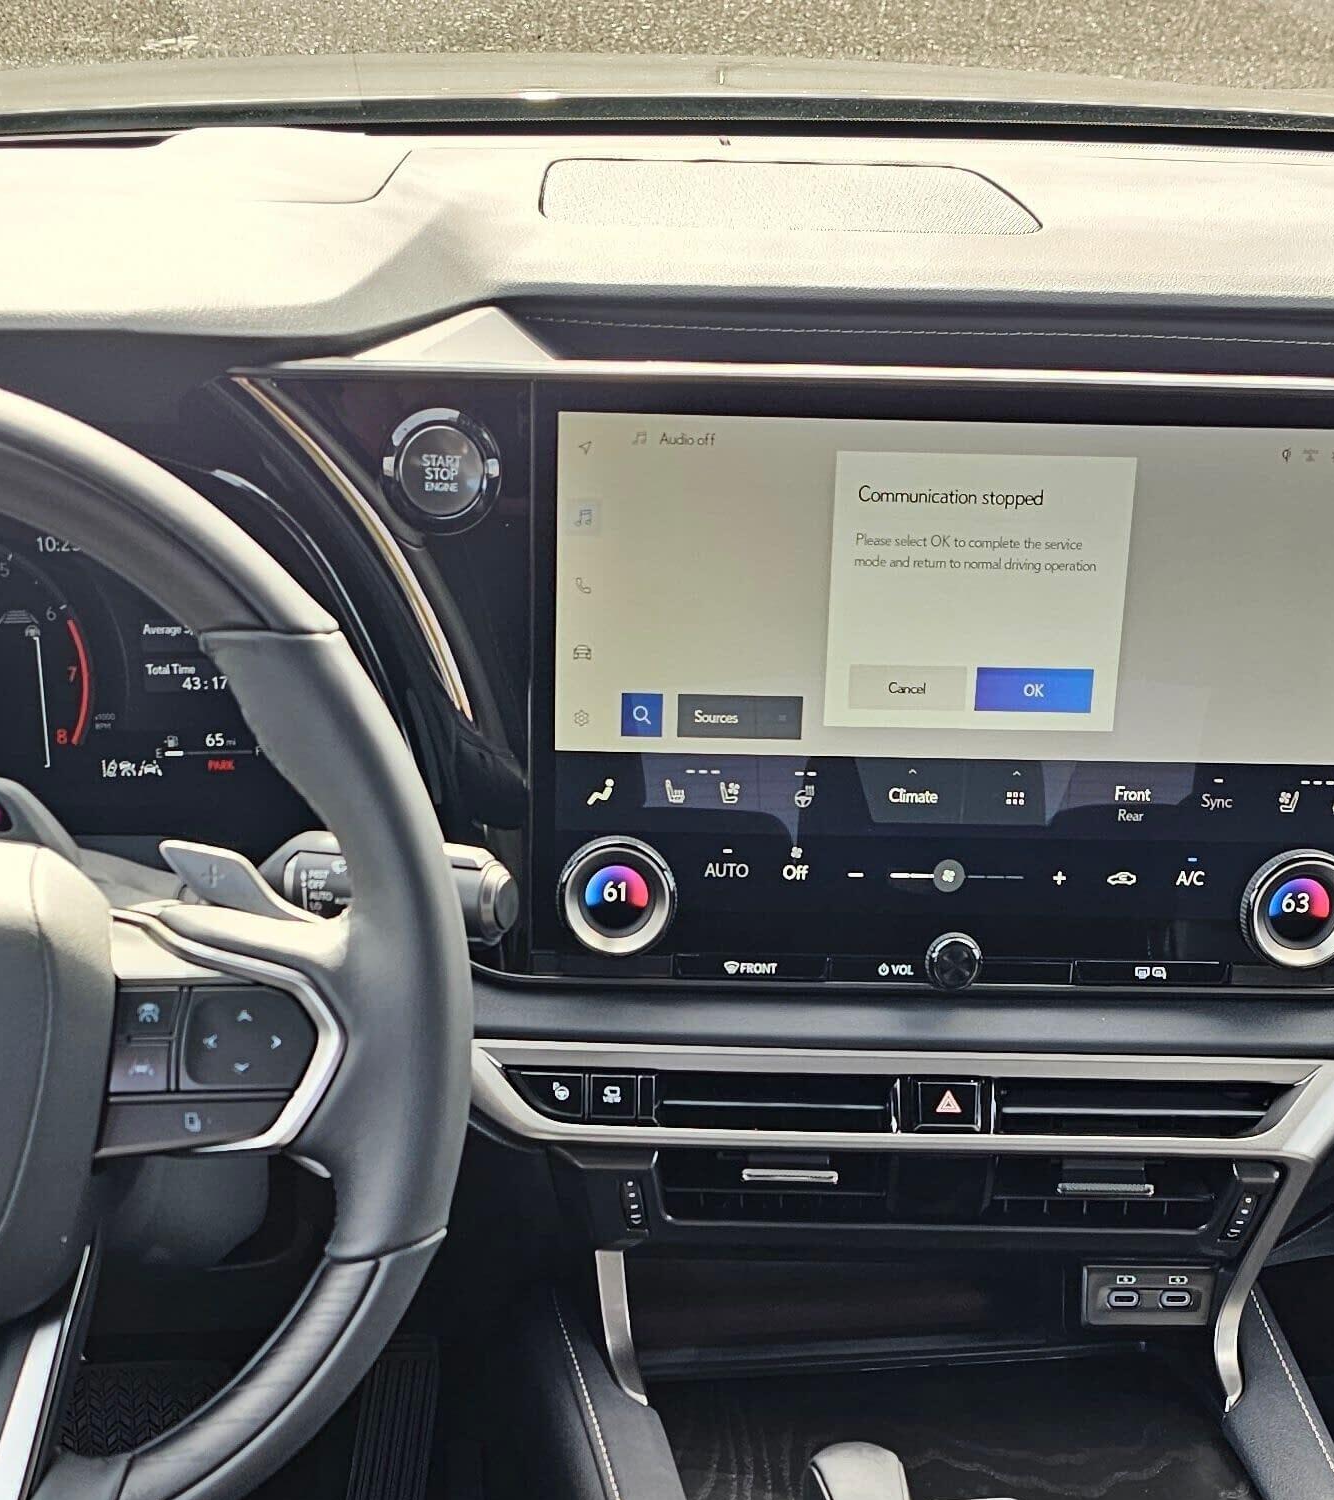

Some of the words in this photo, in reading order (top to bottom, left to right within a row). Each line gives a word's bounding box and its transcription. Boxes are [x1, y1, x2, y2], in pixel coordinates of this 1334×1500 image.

[659, 433, 694, 446] Audio
[697, 432, 716, 446] off
[422, 454, 461, 467] START
[425, 467, 458, 480] STOP
[425, 482, 458, 492] ENGINE
[858, 485, 977, 505] Communication
[982, 489, 1044, 509] stopped
[855, 533, 892, 546] Please
[894, 534, 927, 547] select
[930, 534, 951, 548] OK
[954, 537, 966, 548] to
[968, 536, 1020, 551] complete
[1024, 537, 1042, 550] the
[1045, 539, 1083, 551] service
[854, 556, 886, 568] mode
[889, 556, 910, 568] and
[913, 559, 947, 569] return
[949, 559, 961, 569] to
[963, 557, 1002, 570] normal
[1004, 557, 1041, 573] driving
[1044, 559, 1097, 573] operation
[45, 606, 57, 621] 6
[142, 623, 182, 637] Average
[67, 667, 77, 682] 7
[145, 663, 170, 675] Total
[172, 663, 196, 675] Time
[182, 676, 228, 690] 43:17
[888, 681, 927, 696] Cancel
[1023, 683, 1045, 698] OK
[694, 709, 739, 725] Sources
[56, 729, 68, 744] 8
[205, 733, 225, 747] 65
[888, 786, 940, 804] Climate
[1115, 785, 1152, 802] Front
[1201, 793, 1234, 811] Sync
[1117, 808, 1145, 823] Rear
[704, 862, 749, 879] AUTO
[782, 864, 809, 881] Off
[1175, 870, 1206, 886] A/C
[603, 880, 627, 902] 61
[1281, 892, 1310, 914] 63
[740, 961, 778, 975] FRONT
[891, 964, 915, 977] VOL
